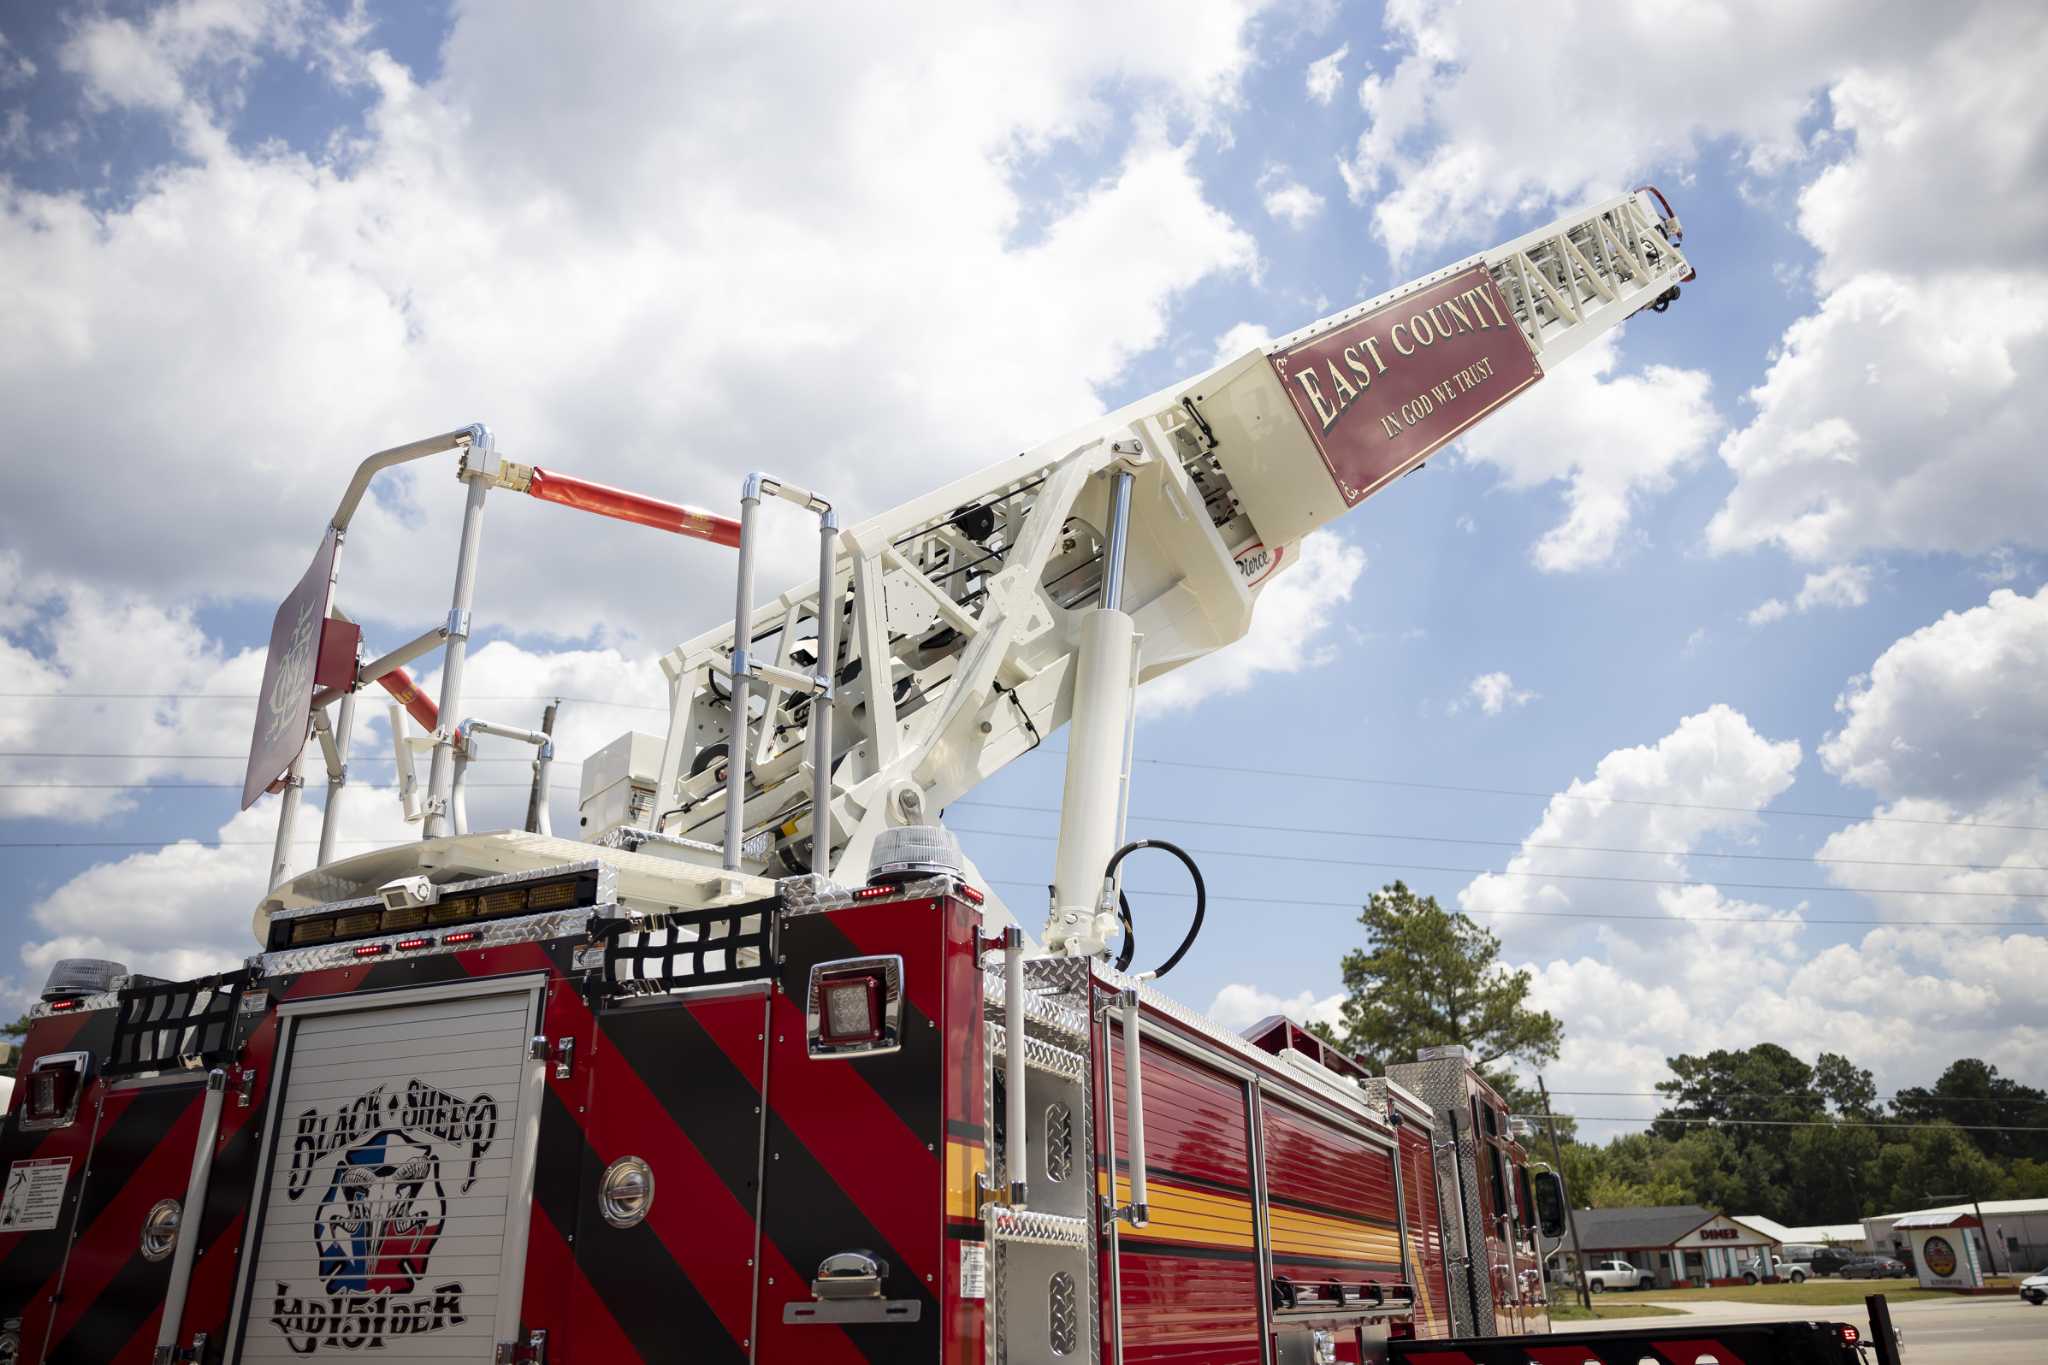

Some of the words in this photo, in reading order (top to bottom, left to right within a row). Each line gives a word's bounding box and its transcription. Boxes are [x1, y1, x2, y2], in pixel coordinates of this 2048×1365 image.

[1296, 336, 1388, 431] EAST
[1391, 283, 1507, 356] COUNTY
[1380, 415, 1401, 440] IN
[1402, 397, 1433, 427] GOD
[1431, 380, 1457, 404] WE
[1455, 357, 1495, 392] TRUST
[288, 1084, 388, 1200] BLACK
[402, 1078, 498, 1193] SHEEP
